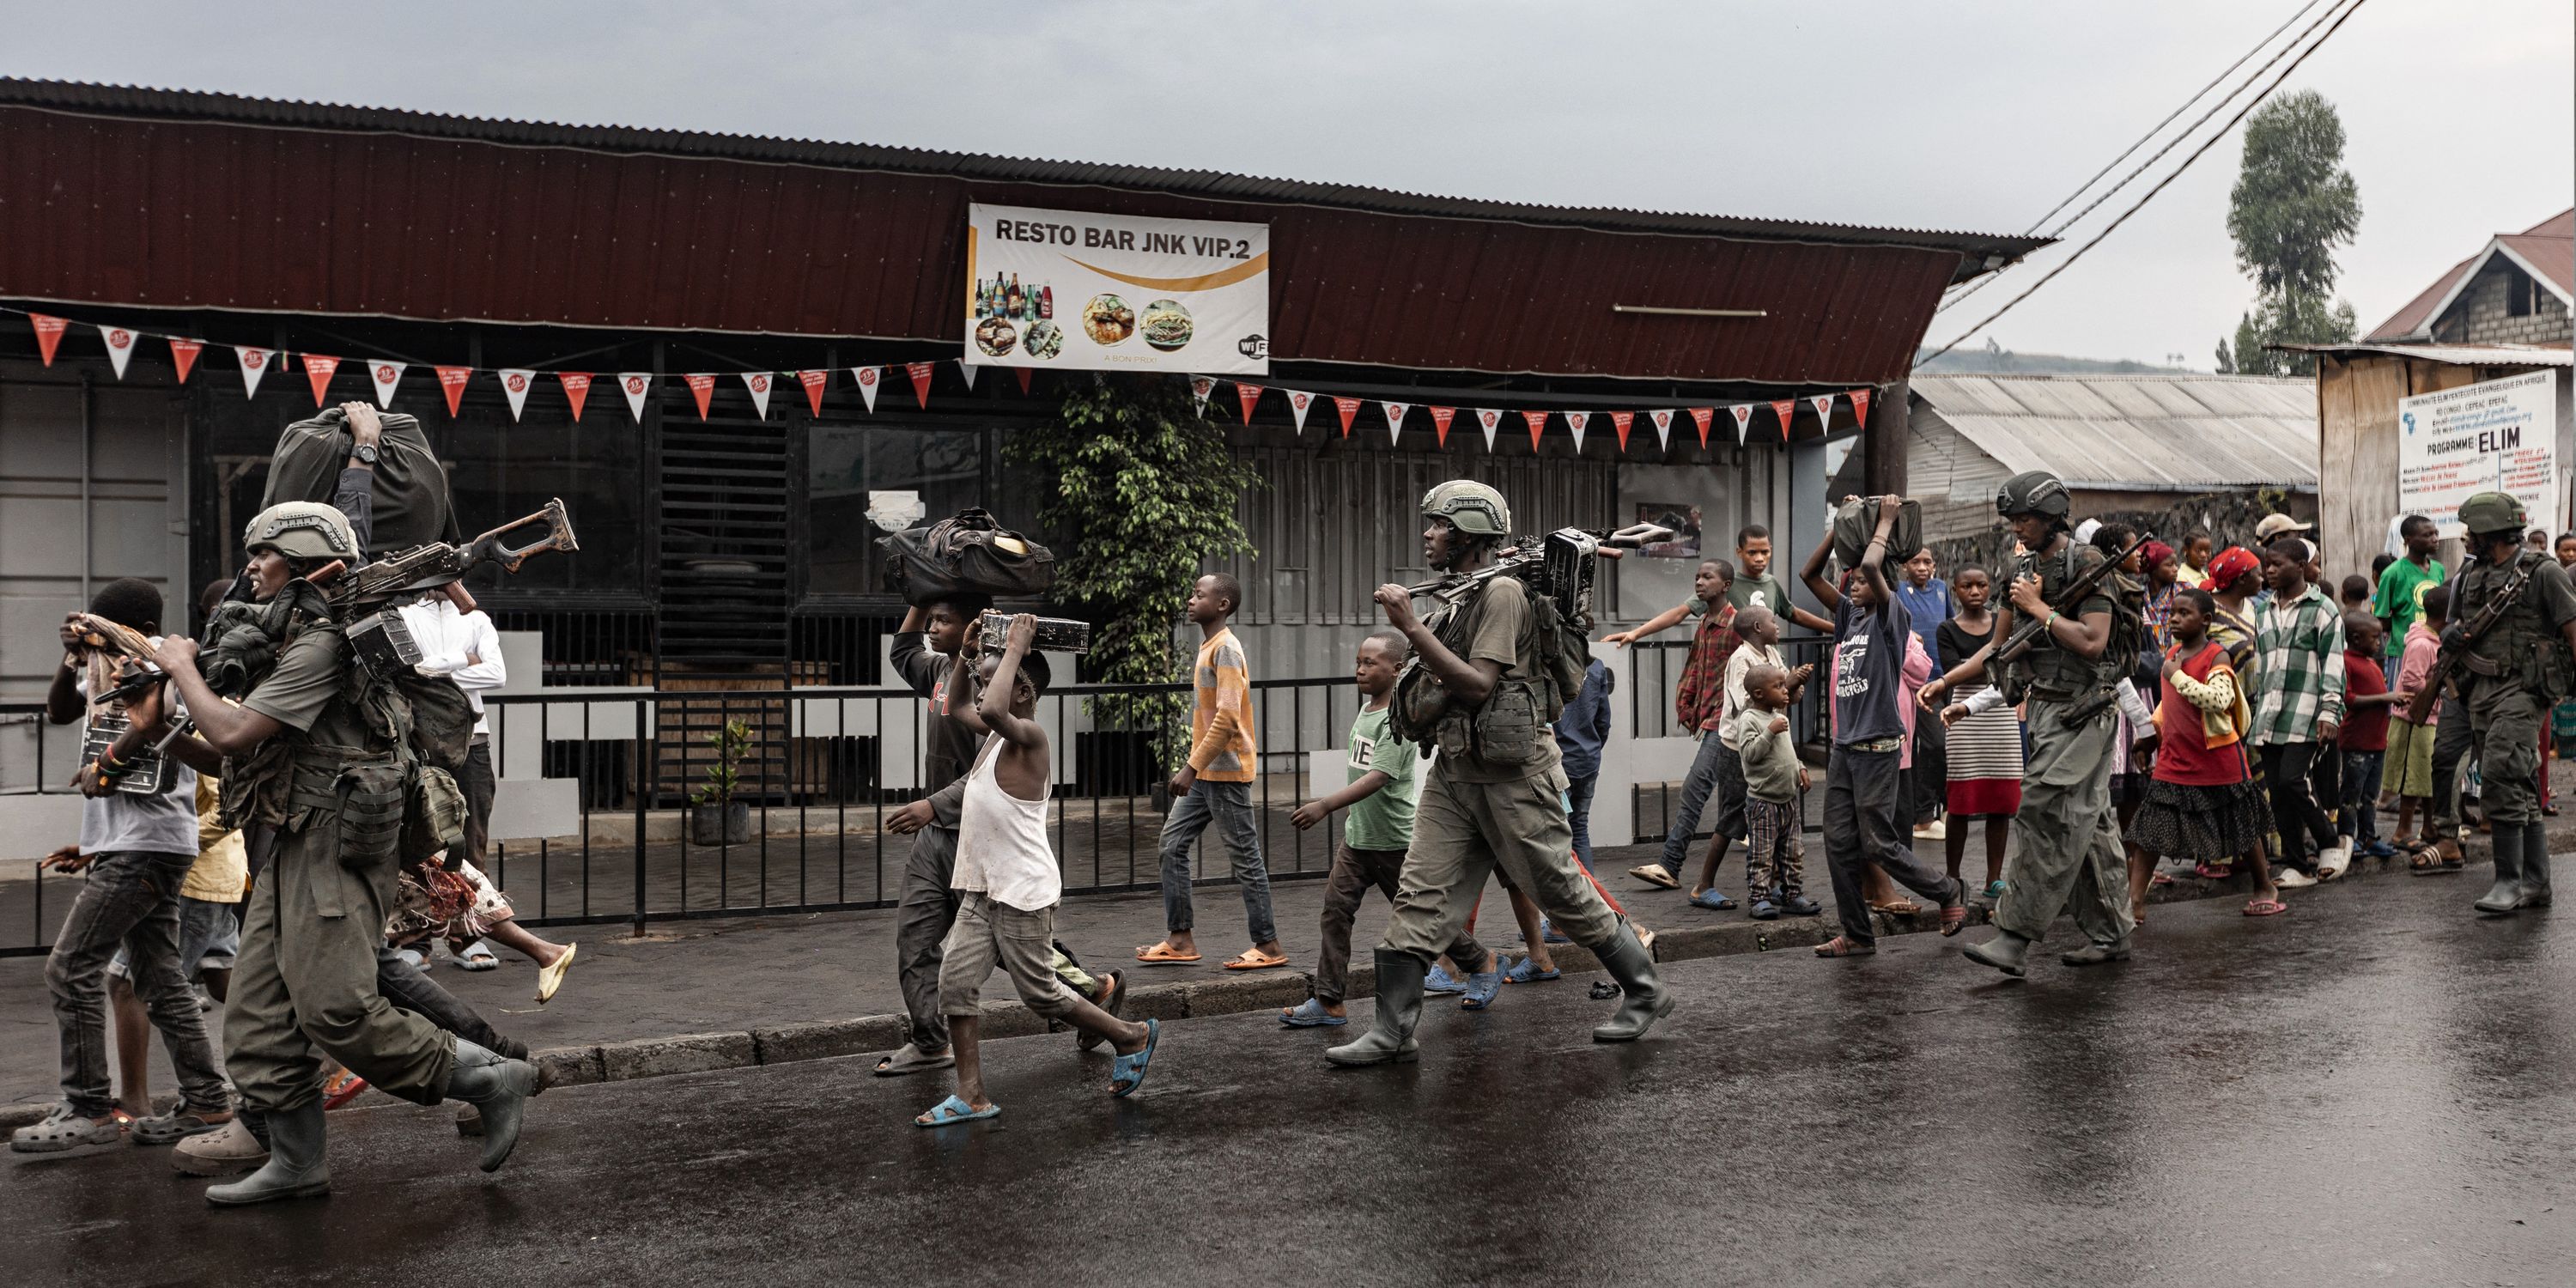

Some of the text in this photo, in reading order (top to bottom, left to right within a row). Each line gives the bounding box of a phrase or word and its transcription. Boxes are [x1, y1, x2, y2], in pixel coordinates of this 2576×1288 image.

[996, 218, 1250, 259] RESTO BAR JNK VIP.2
[1241, 341, 1267, 352] WiF
[2516, 378, 2523, 388] EN
[2524, 373, 2547, 386] AFRIQUE
[2479, 426, 2520, 453] ELIM
